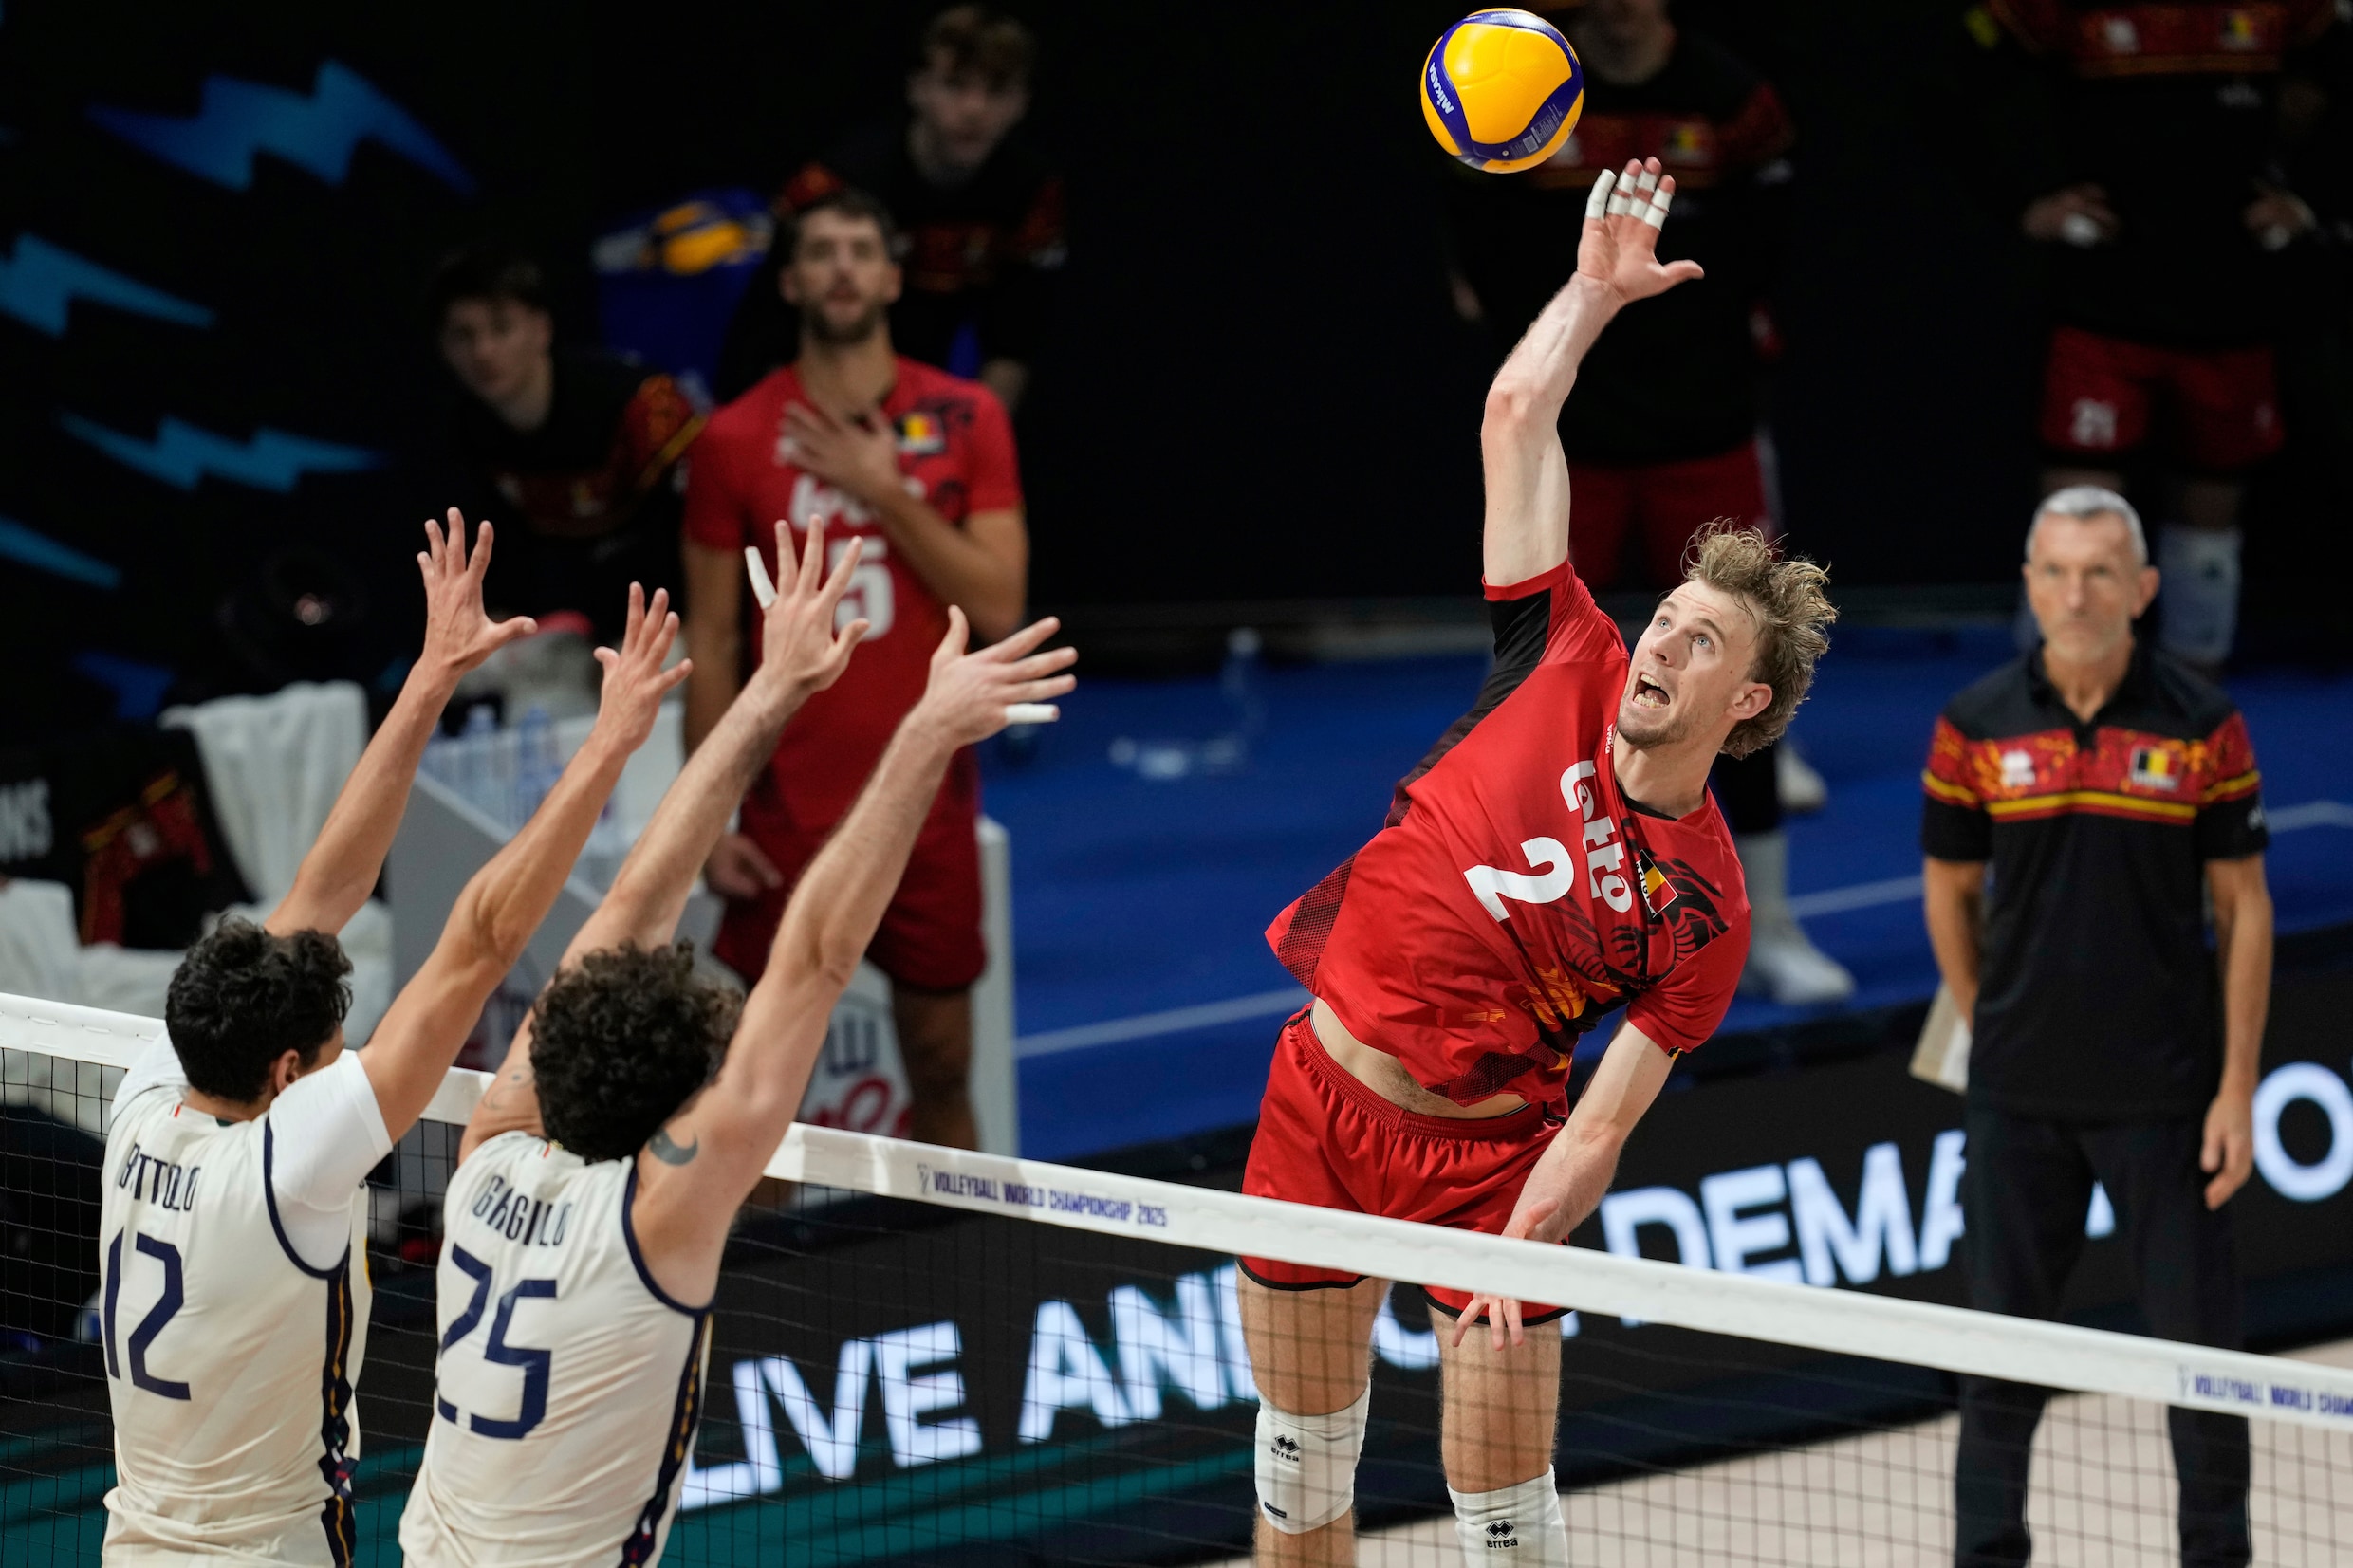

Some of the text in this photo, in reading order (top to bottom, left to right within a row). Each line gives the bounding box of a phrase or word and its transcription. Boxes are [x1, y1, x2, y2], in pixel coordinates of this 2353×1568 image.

[1463, 836, 1574, 923] 2
[933, 1170, 999, 1202] VOLLEYBALL
[1004, 1182, 1045, 1208] WORLD
[104, 1225, 192, 1402] 12
[436, 1242, 558, 1440] 25
